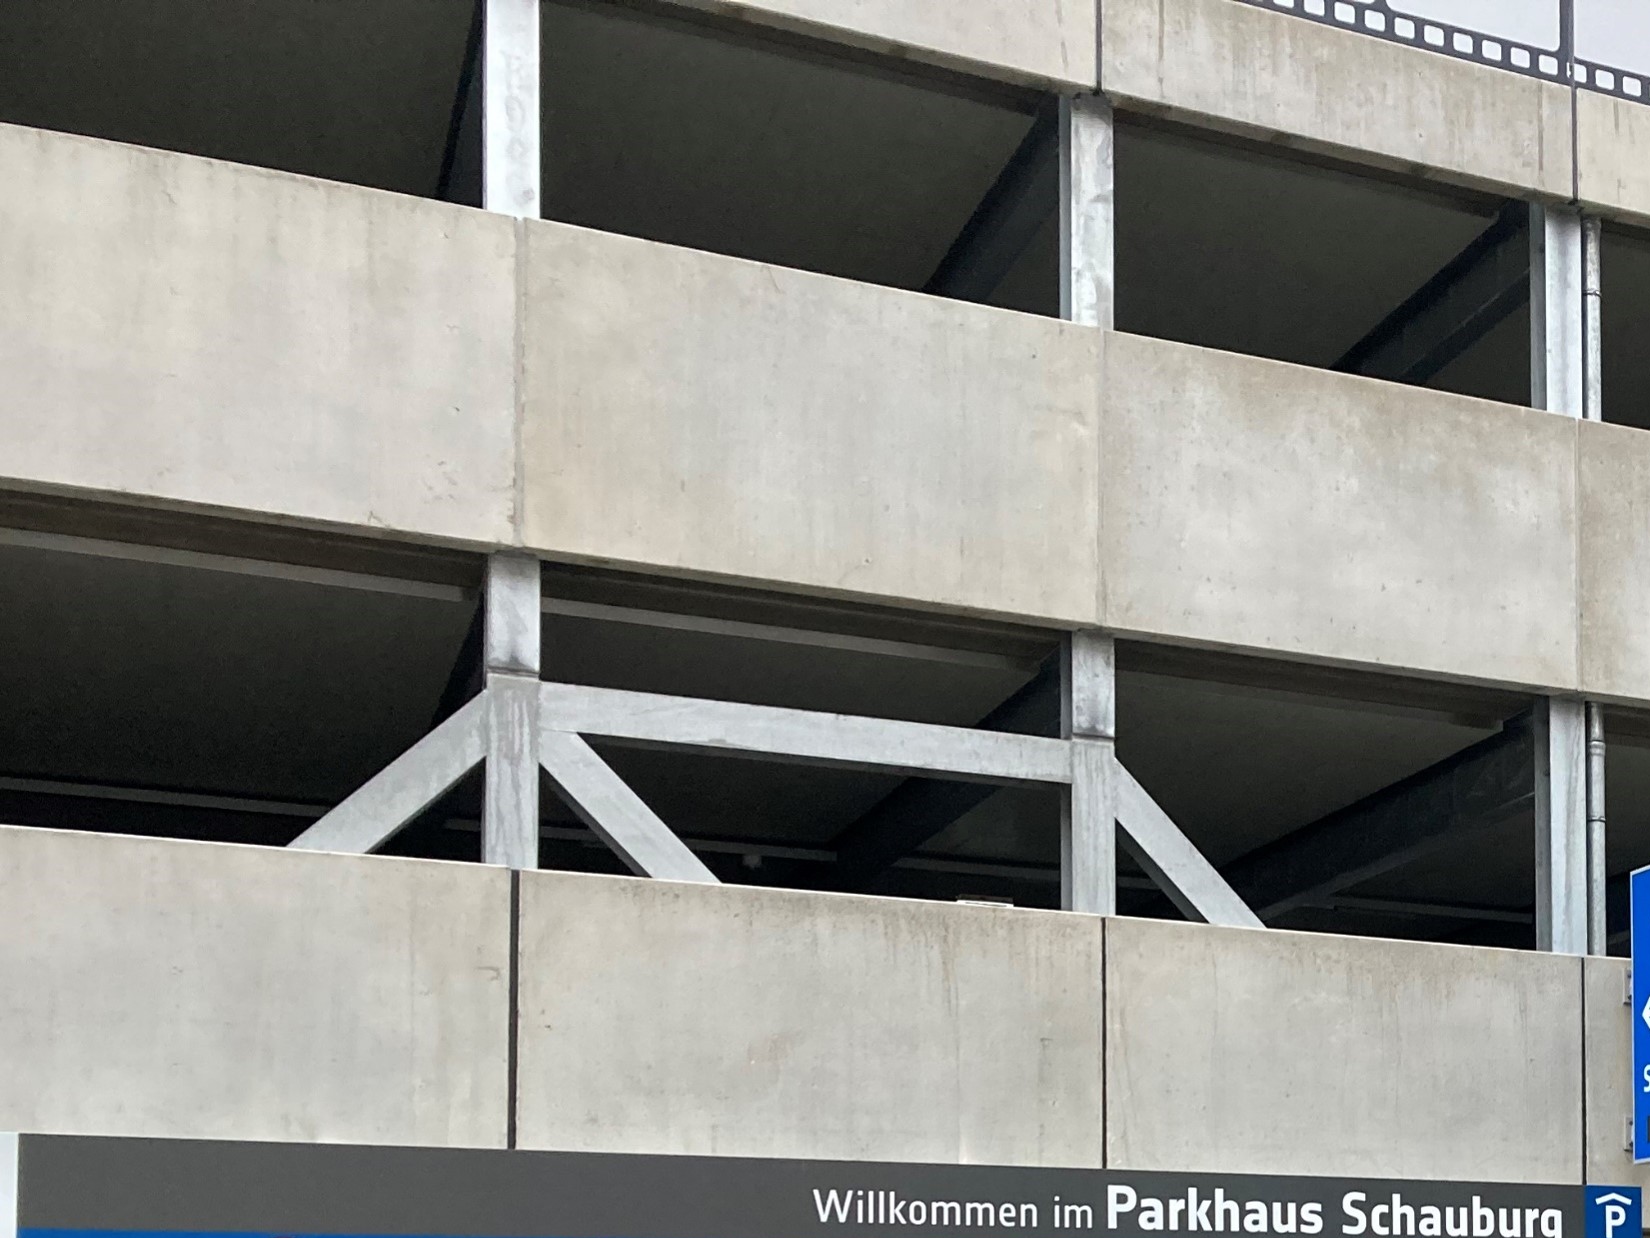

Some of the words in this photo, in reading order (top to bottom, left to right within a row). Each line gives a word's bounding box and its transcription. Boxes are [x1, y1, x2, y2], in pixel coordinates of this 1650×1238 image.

[812, 1188, 1038, 1228] Willkommen
[1053, 1196, 1094, 1229] im
[1107, 1184, 1324, 1235] Parkhaus
